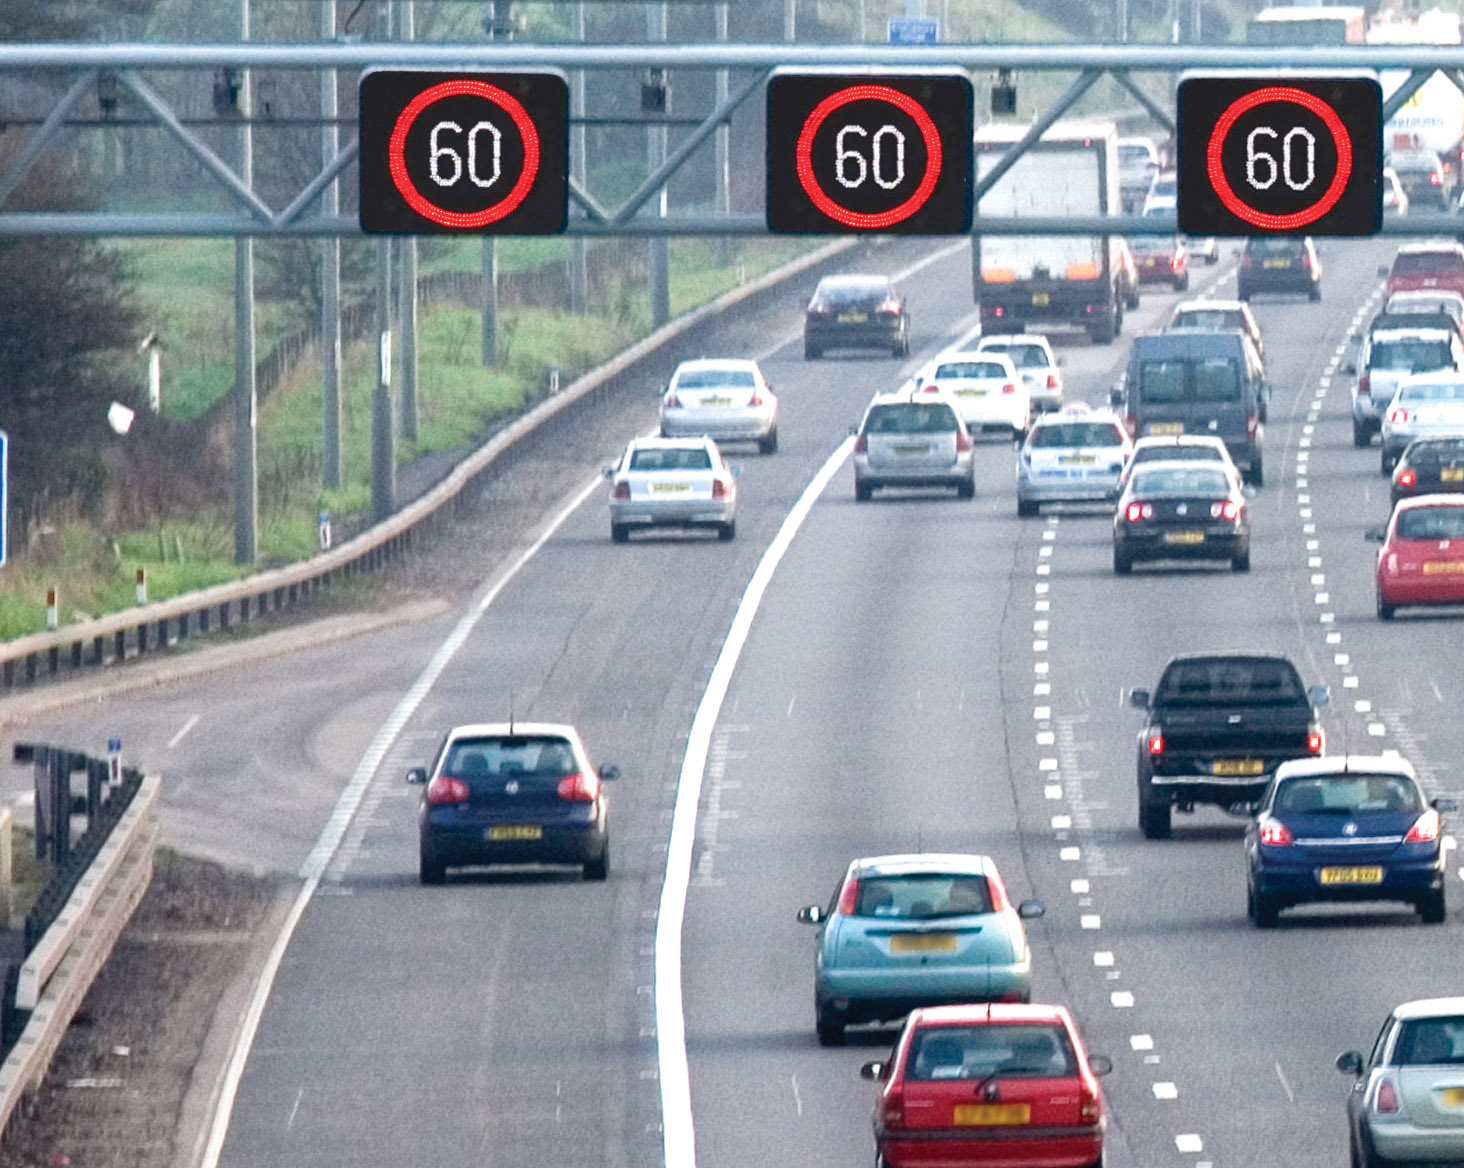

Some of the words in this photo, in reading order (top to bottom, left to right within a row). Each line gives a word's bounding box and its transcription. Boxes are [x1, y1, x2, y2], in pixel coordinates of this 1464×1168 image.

[429, 121, 501, 188] 60
[835, 124, 905, 189] 60
[1246, 126, 1315, 191] 60
